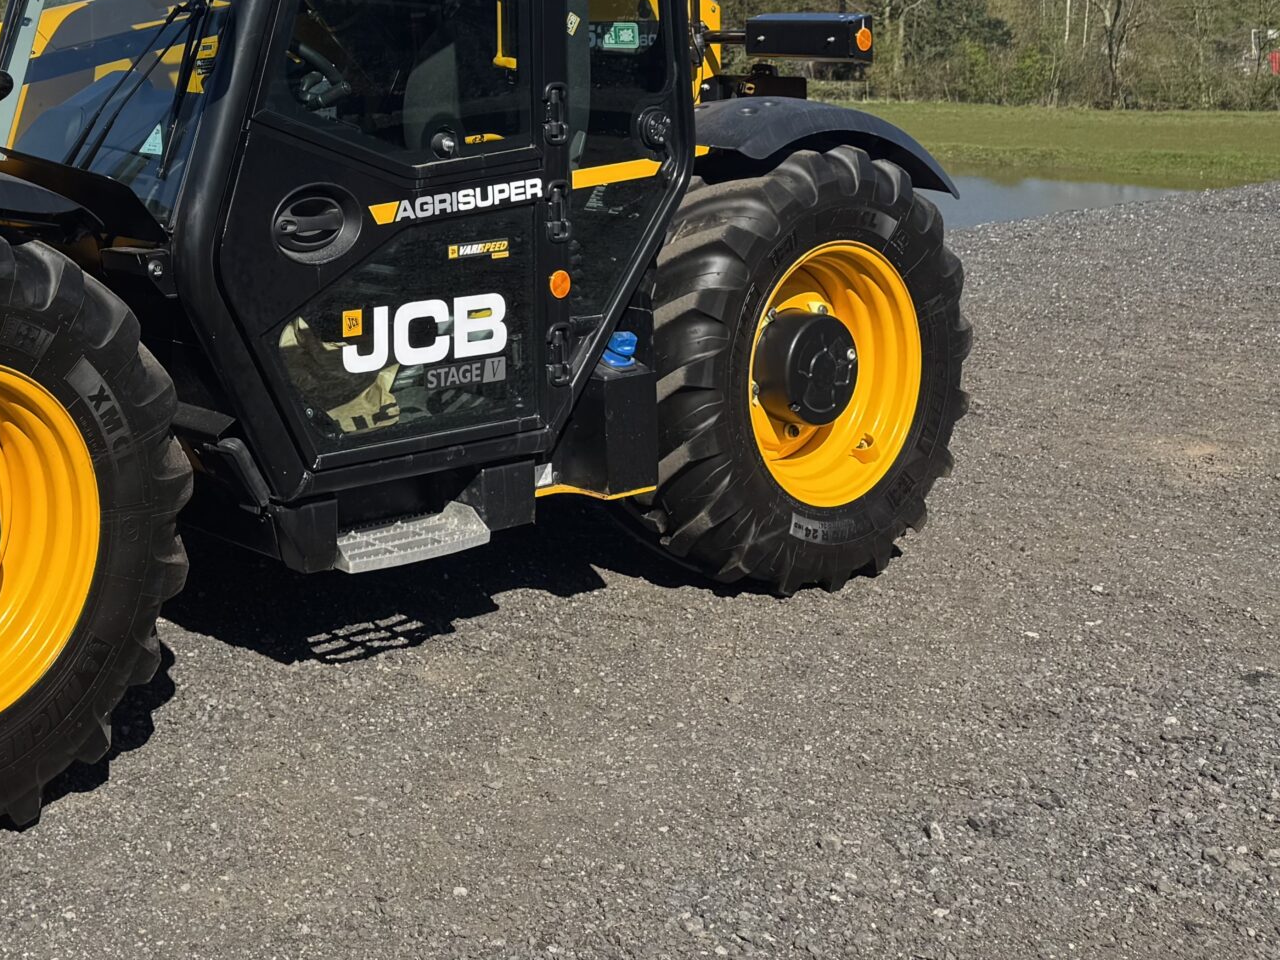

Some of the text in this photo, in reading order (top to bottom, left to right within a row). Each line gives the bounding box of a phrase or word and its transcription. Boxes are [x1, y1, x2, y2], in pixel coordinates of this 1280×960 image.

[395, 178, 543, 222] AGRISUPER
[459, 241, 508, 256] VARISPEED
[342, 293, 507, 373] JCB
[427, 360, 501, 388] STAGE V
[804, 527, 819, 540] 24
